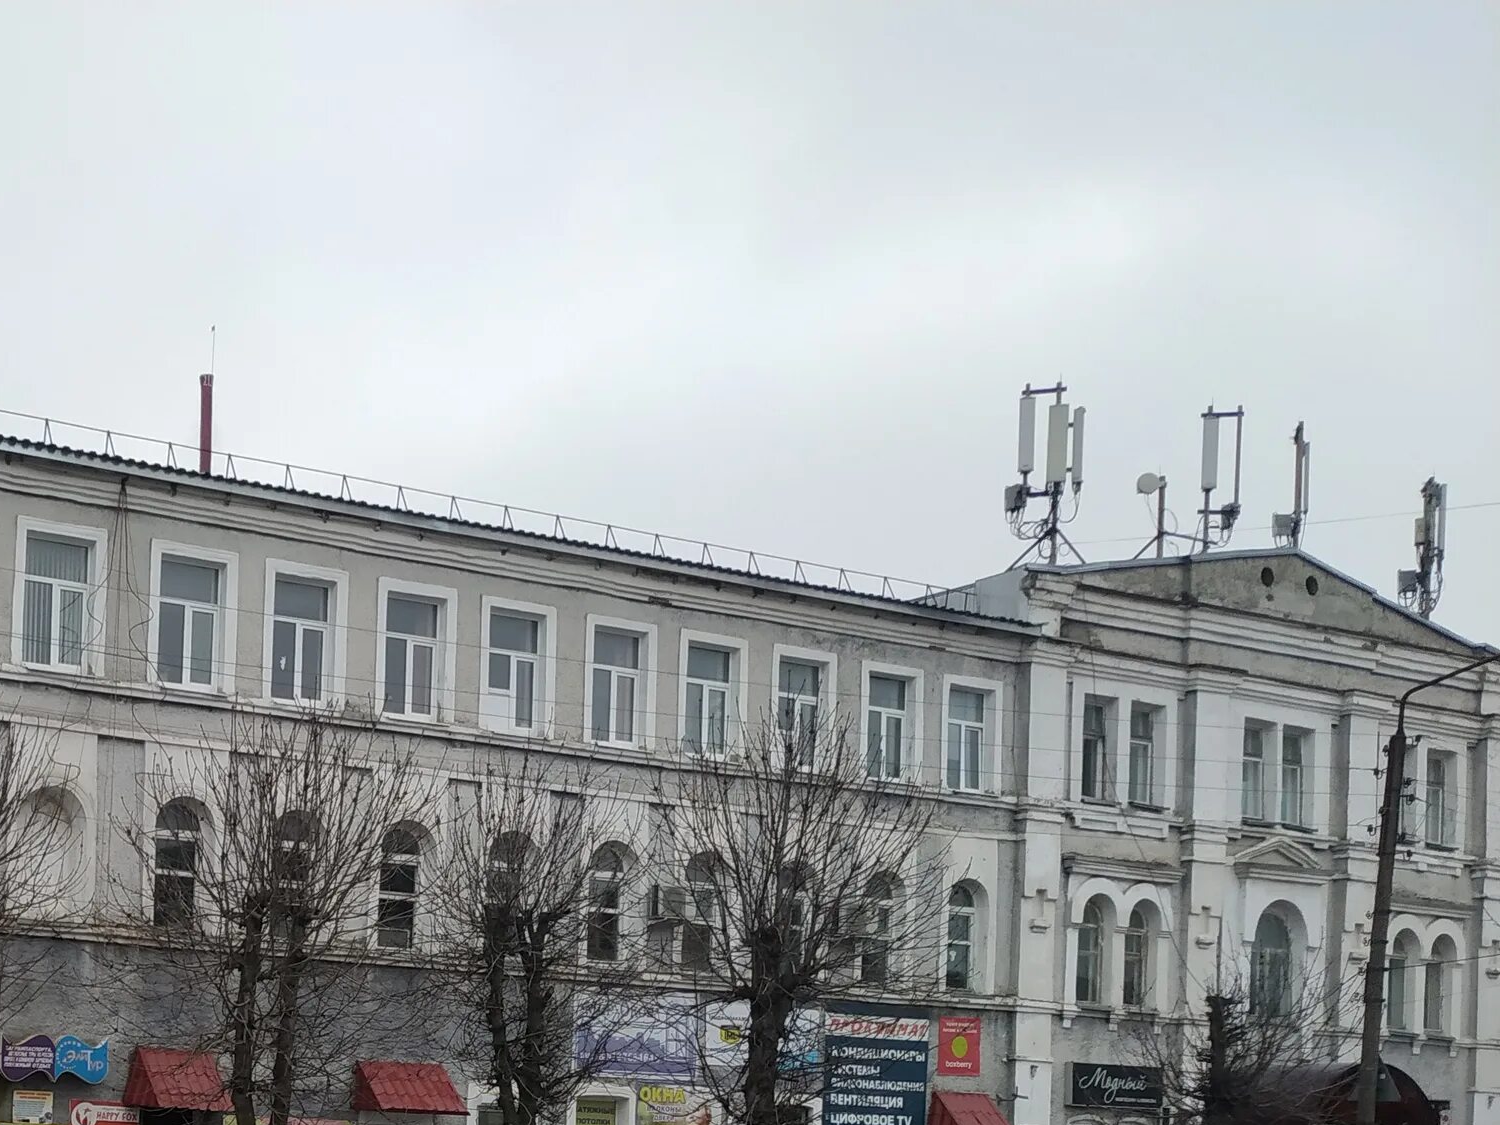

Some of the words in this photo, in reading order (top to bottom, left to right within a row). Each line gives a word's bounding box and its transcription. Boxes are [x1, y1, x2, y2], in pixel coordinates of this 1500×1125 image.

[1079, 1067, 1147, 1104] Модный
[640, 1086, 687, 1104] ОКНА
[830, 1093, 904, 1109] ВЕНТИЛЯЦИЯ
[96, 1111, 119, 1121] HAPPY
[122, 1112, 138, 1122] FOX
[577, 1106, 615, 1115] АТЯЖНЫЕ
[830, 1113, 895, 1125] ЦИФРОВОЕ
